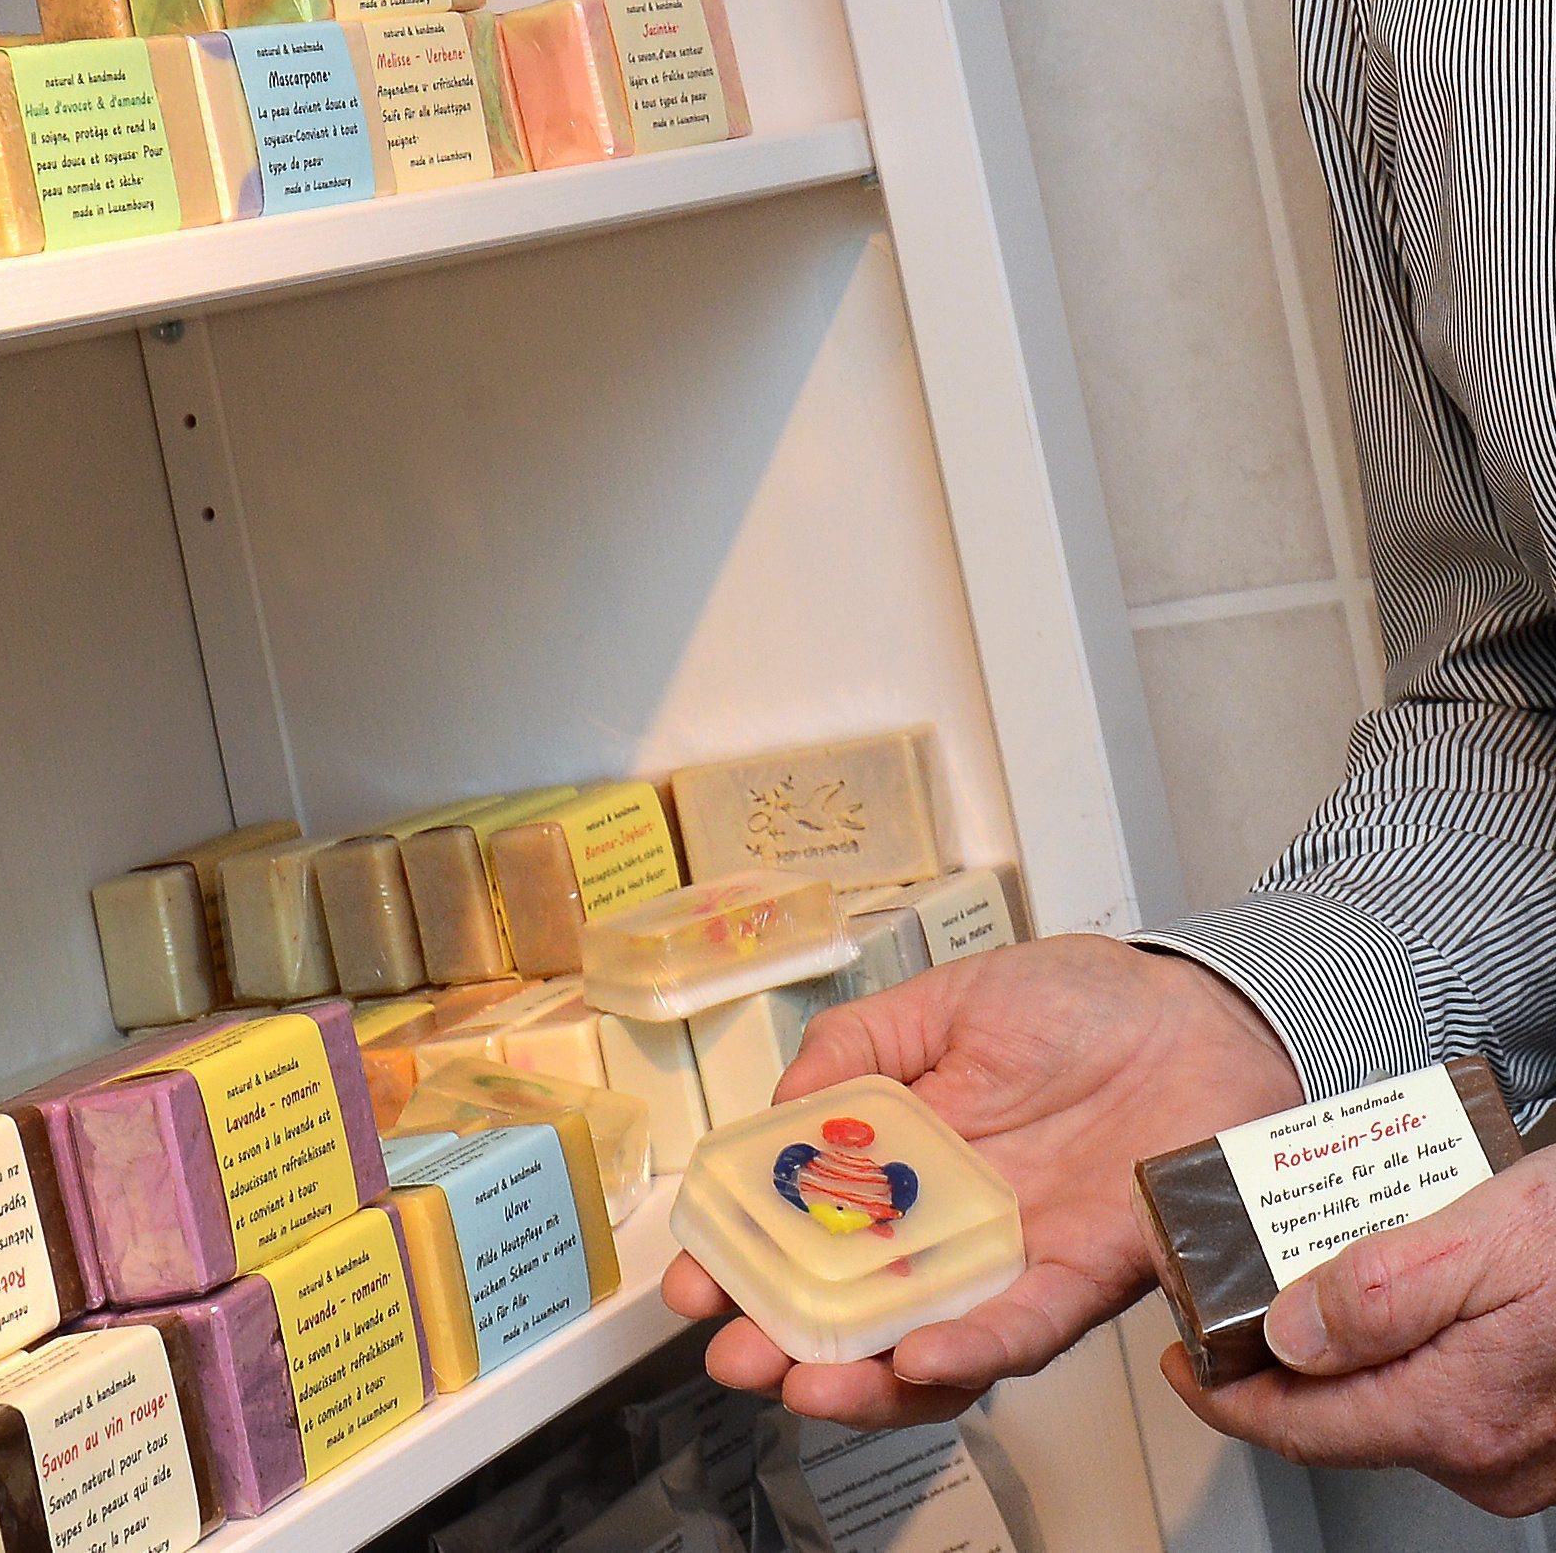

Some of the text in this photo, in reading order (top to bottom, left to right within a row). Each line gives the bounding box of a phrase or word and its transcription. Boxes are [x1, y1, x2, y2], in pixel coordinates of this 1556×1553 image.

[223, 1107, 331, 1169] Ce savon à la lavande est
[225, 1101, 266, 1133] Lavande
[1270, 1089, 1404, 1139] natural & handmade
[230, 1137, 335, 1199] adoucissant rafraîchissant
[1260, 1137, 1462, 1207] Naturseife für alle Haut-
[1369, 1180, 1411, 1203] müde
[1418, 1165, 1458, 1187] Haut
[235, 1214, 245, 1230] et
[249, 1193, 285, 1223] convient
[288, 1188, 294, 1203] à
[1281, 1246, 1299, 1260] zu
[41, 1443, 78, 1479] Savon
[84, 1430, 98, 1451] au
[104, 1416, 123, 1439] vin
[48, 1432, 168, 1515] Savon naturel pour tous
[54, 1463, 171, 1548] types de peaux qui aide
